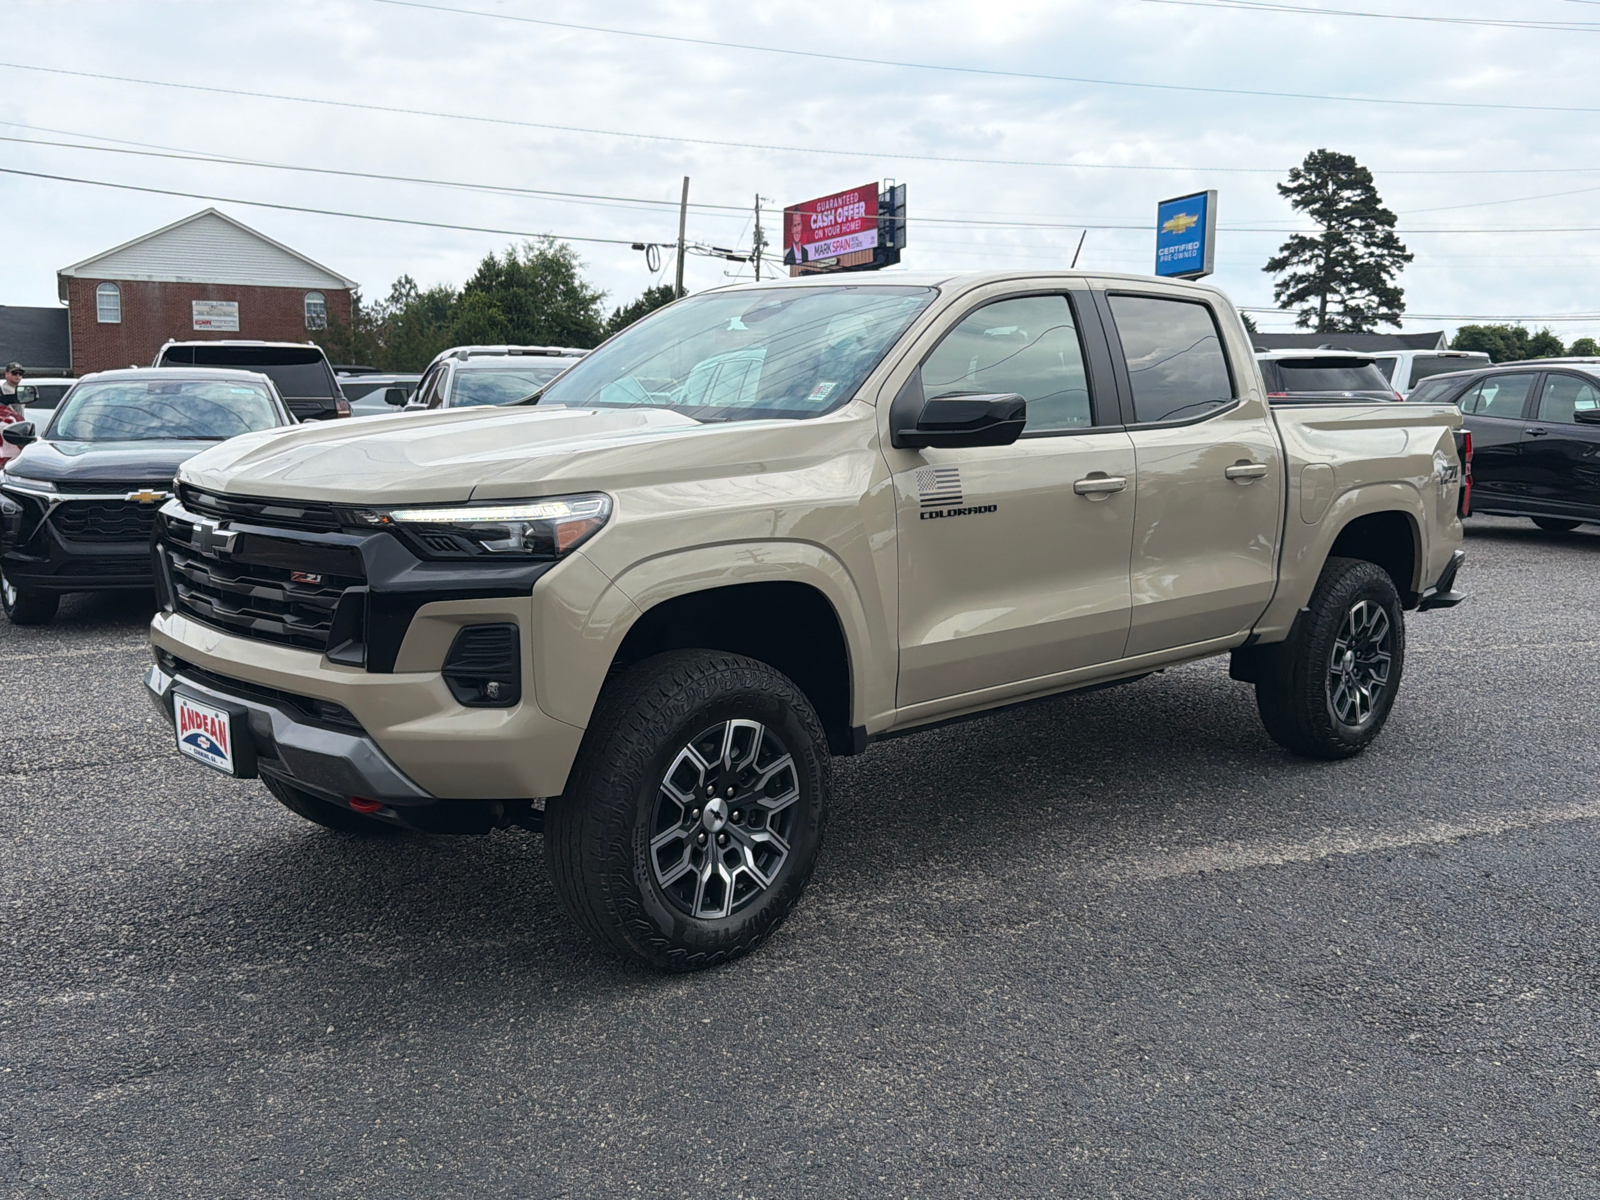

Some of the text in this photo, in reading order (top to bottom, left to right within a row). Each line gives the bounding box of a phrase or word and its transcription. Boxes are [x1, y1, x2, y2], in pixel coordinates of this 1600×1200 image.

[816, 193, 858, 211] GUARANTEED
[810, 201, 866, 229] CASH OFFER
[814, 220, 861, 239] ON YOUR HOME!
[814, 239, 850, 256] MARK SPAIN
[1159, 242, 1199, 255] CERTIFIED
[1160, 250, 1197, 261] PRE-OWNED
[920, 504, 998, 520] COLORADO
[291, 571, 322, 584] Z71
[181, 705, 228, 755] ANDEAN
